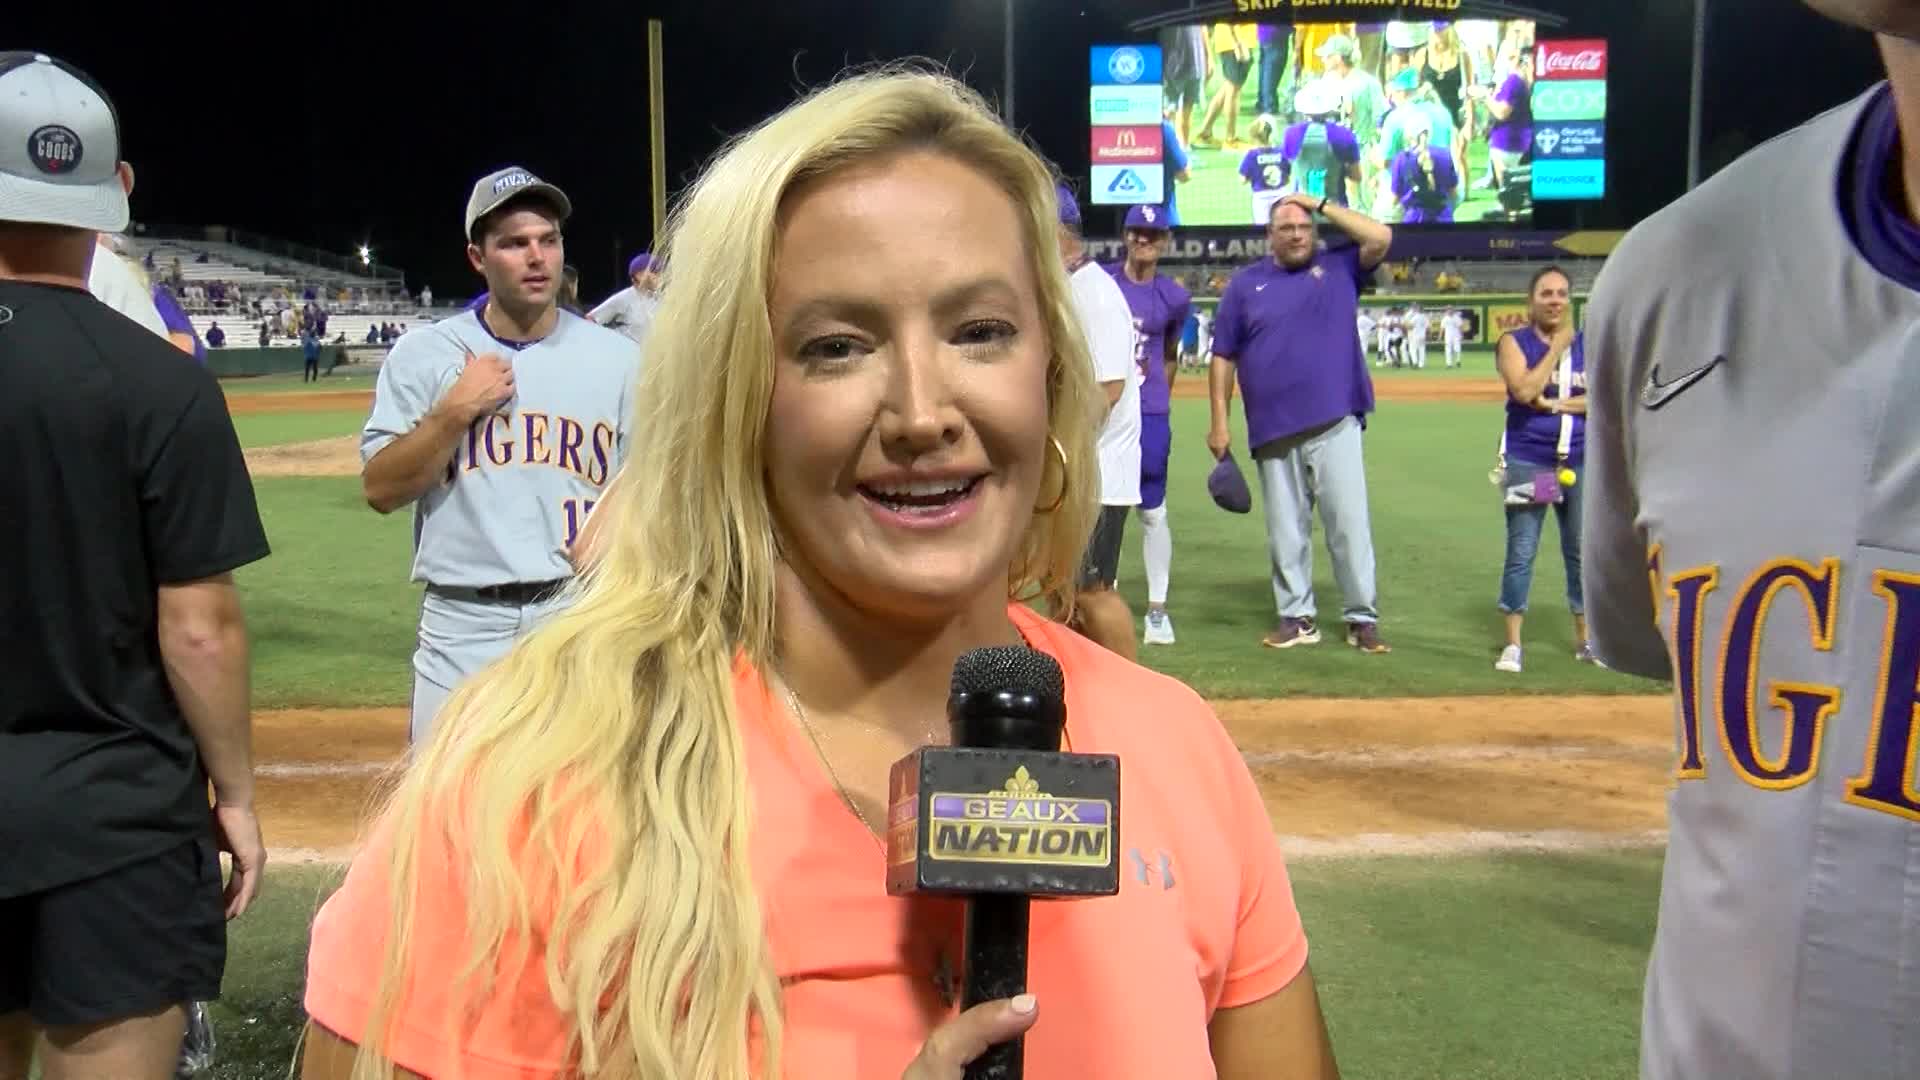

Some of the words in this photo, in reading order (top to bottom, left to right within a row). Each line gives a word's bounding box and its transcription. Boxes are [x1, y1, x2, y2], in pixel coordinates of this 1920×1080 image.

[444, 409, 614, 487] IGERS
[559, 498, 597, 549] 1
[963, 799, 1081, 822] GEAUX
[935, 824, 1105, 857] NATION
